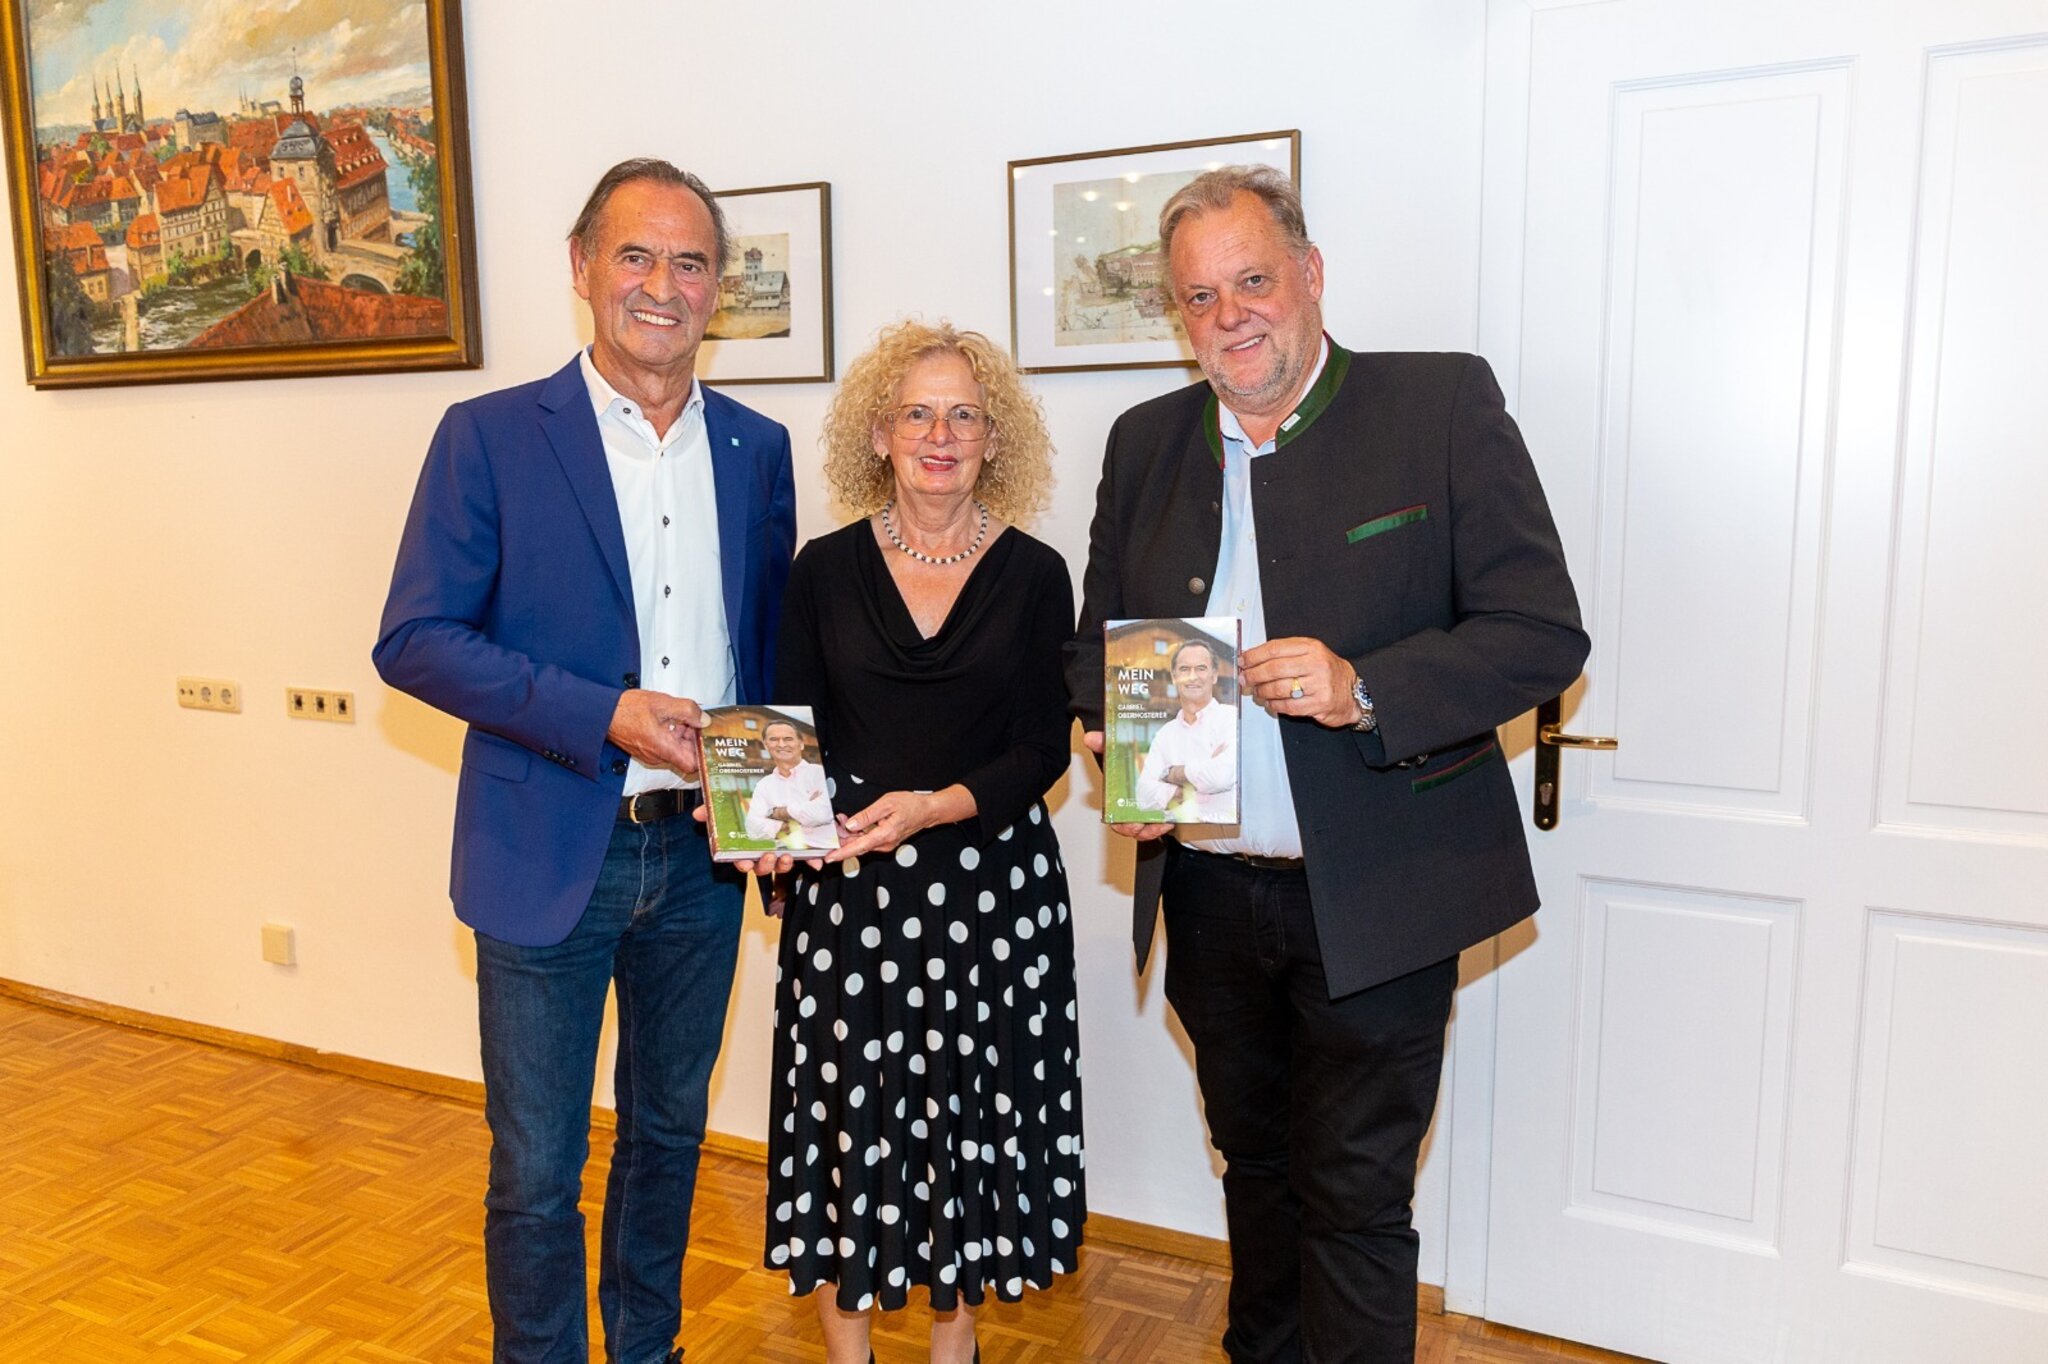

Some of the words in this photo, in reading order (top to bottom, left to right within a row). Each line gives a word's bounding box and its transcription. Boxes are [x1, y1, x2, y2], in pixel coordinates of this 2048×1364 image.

[1118, 669, 1154, 680] MEIN
[1118, 683, 1149, 695] WEG
[715, 738, 748, 747] MEIN
[715, 748, 746, 757] WEG
